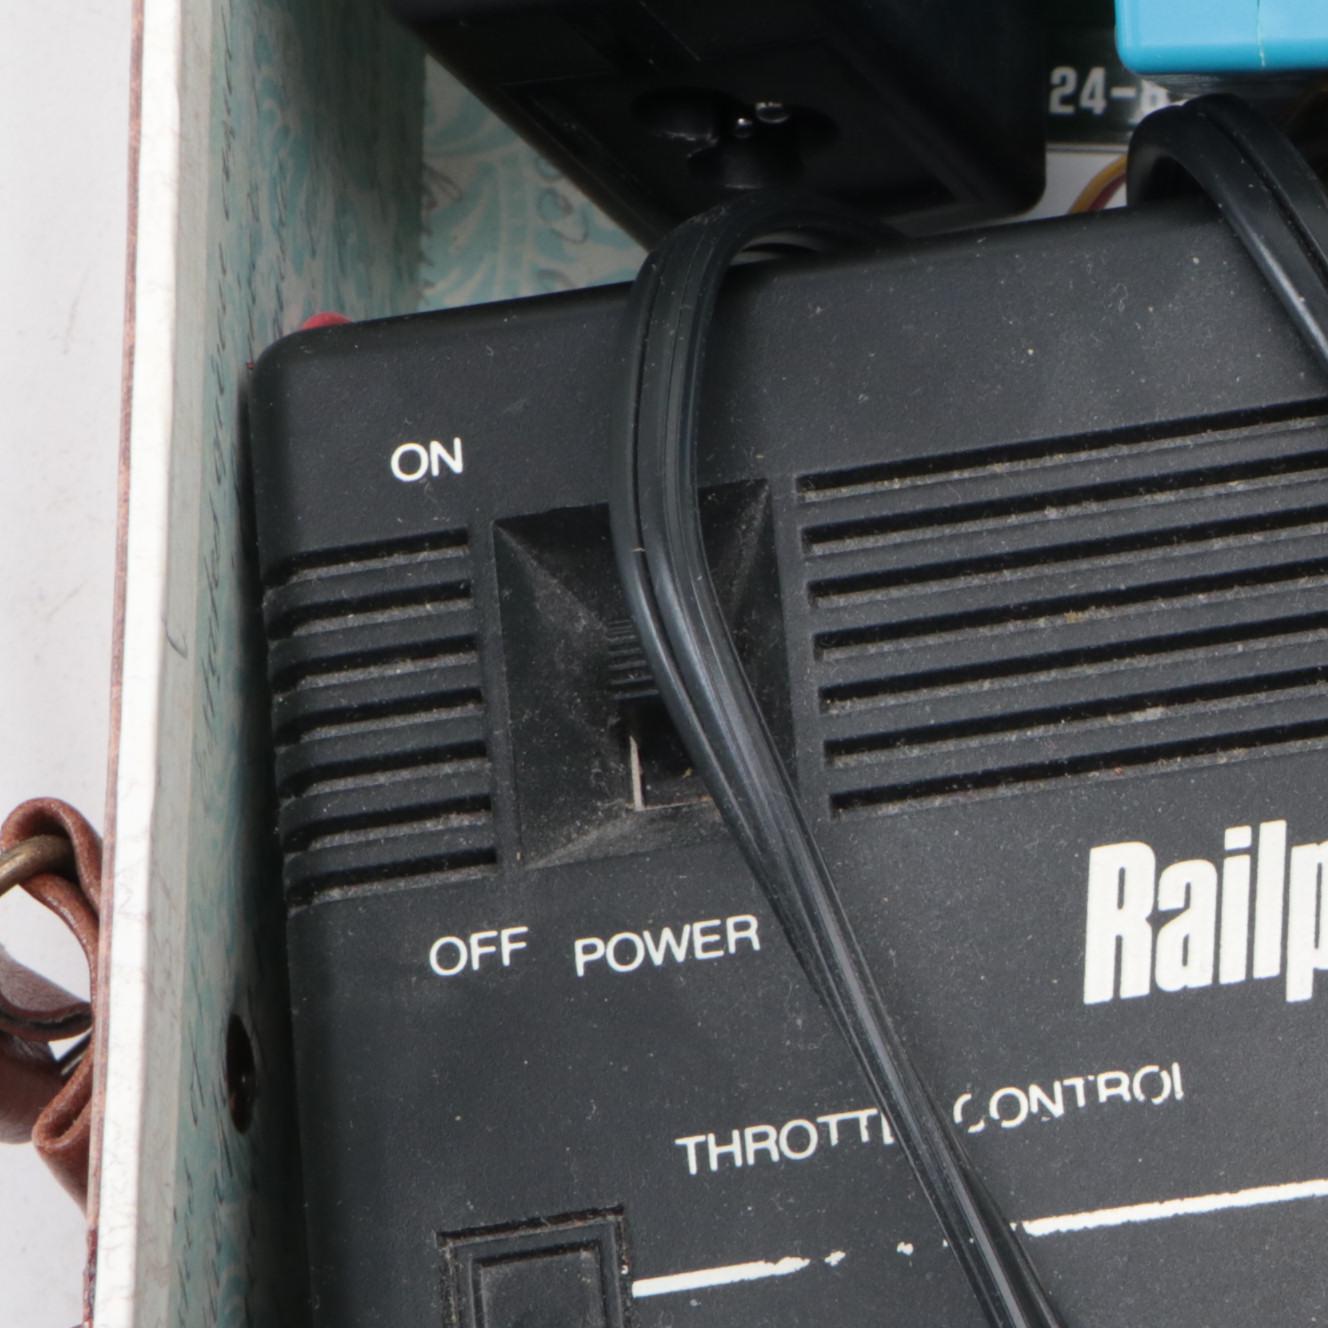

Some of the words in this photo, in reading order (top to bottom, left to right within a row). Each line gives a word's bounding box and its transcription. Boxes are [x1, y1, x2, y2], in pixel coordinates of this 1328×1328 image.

[391, 437, 464, 482] ON
[429, 926, 529, 977] OFF
[574, 913, 761, 978] POWER
